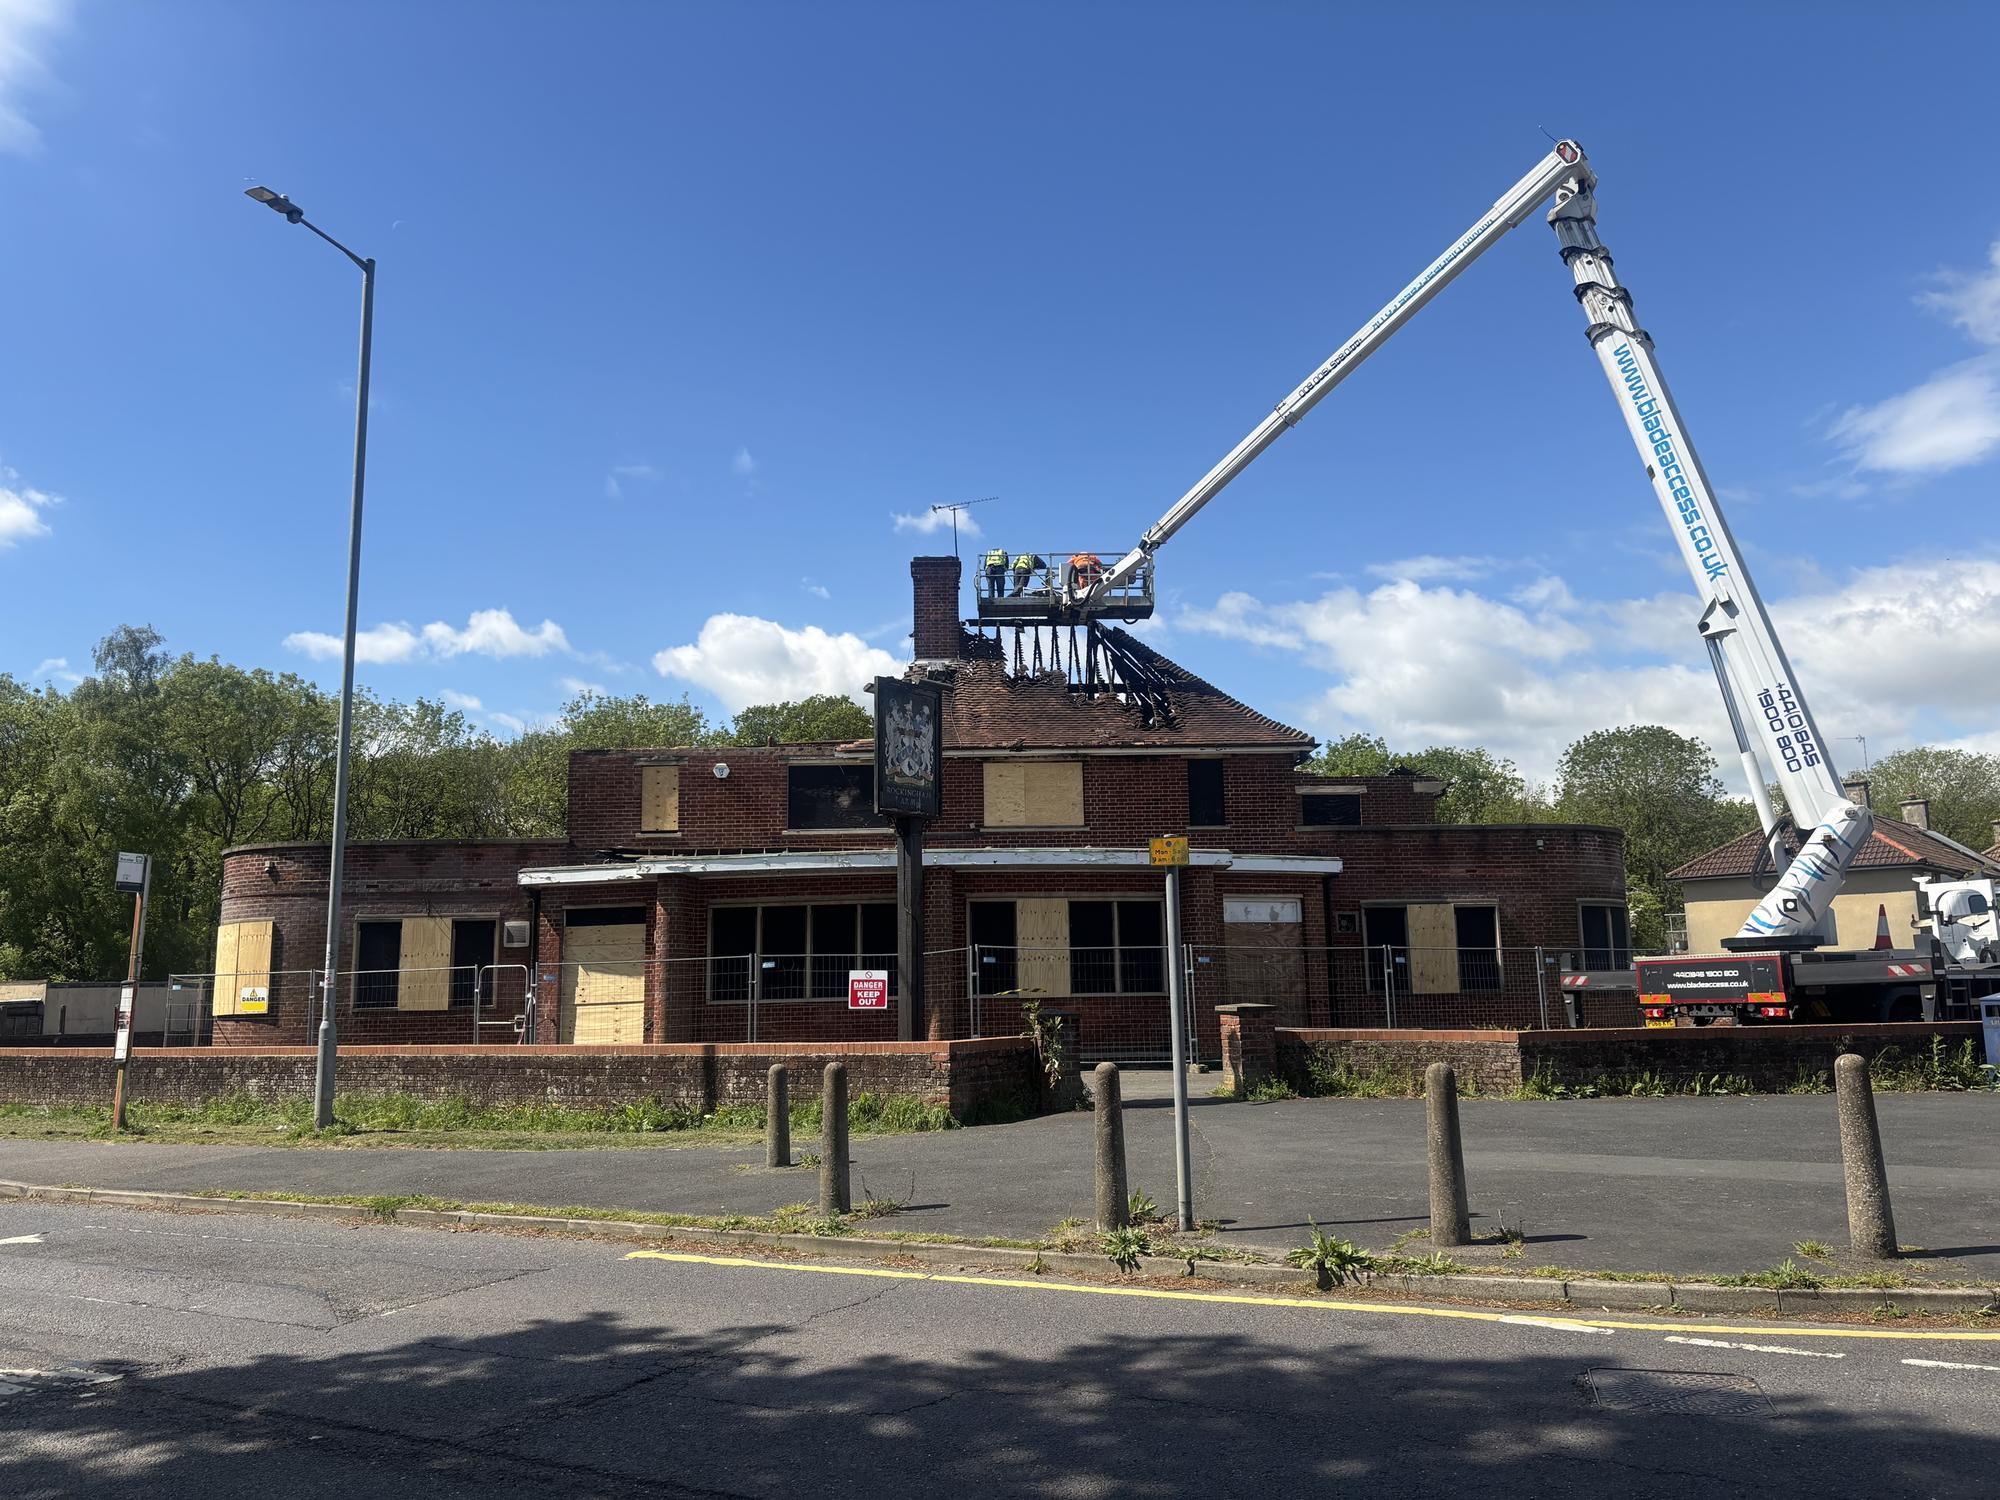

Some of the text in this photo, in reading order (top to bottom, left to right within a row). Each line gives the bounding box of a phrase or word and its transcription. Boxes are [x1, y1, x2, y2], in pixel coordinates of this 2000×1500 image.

[1613, 342, 1728, 583] www.bladeaccess.co.uk
[1757, 688, 1802, 773] 1900 800
[1776, 682, 1820, 767] +44(0)845
[853, 981, 883, 989] DANGER
[858, 998, 877, 1006] OUT
[1666, 980, 1749, 989] www.bladeaccess.co.uk
